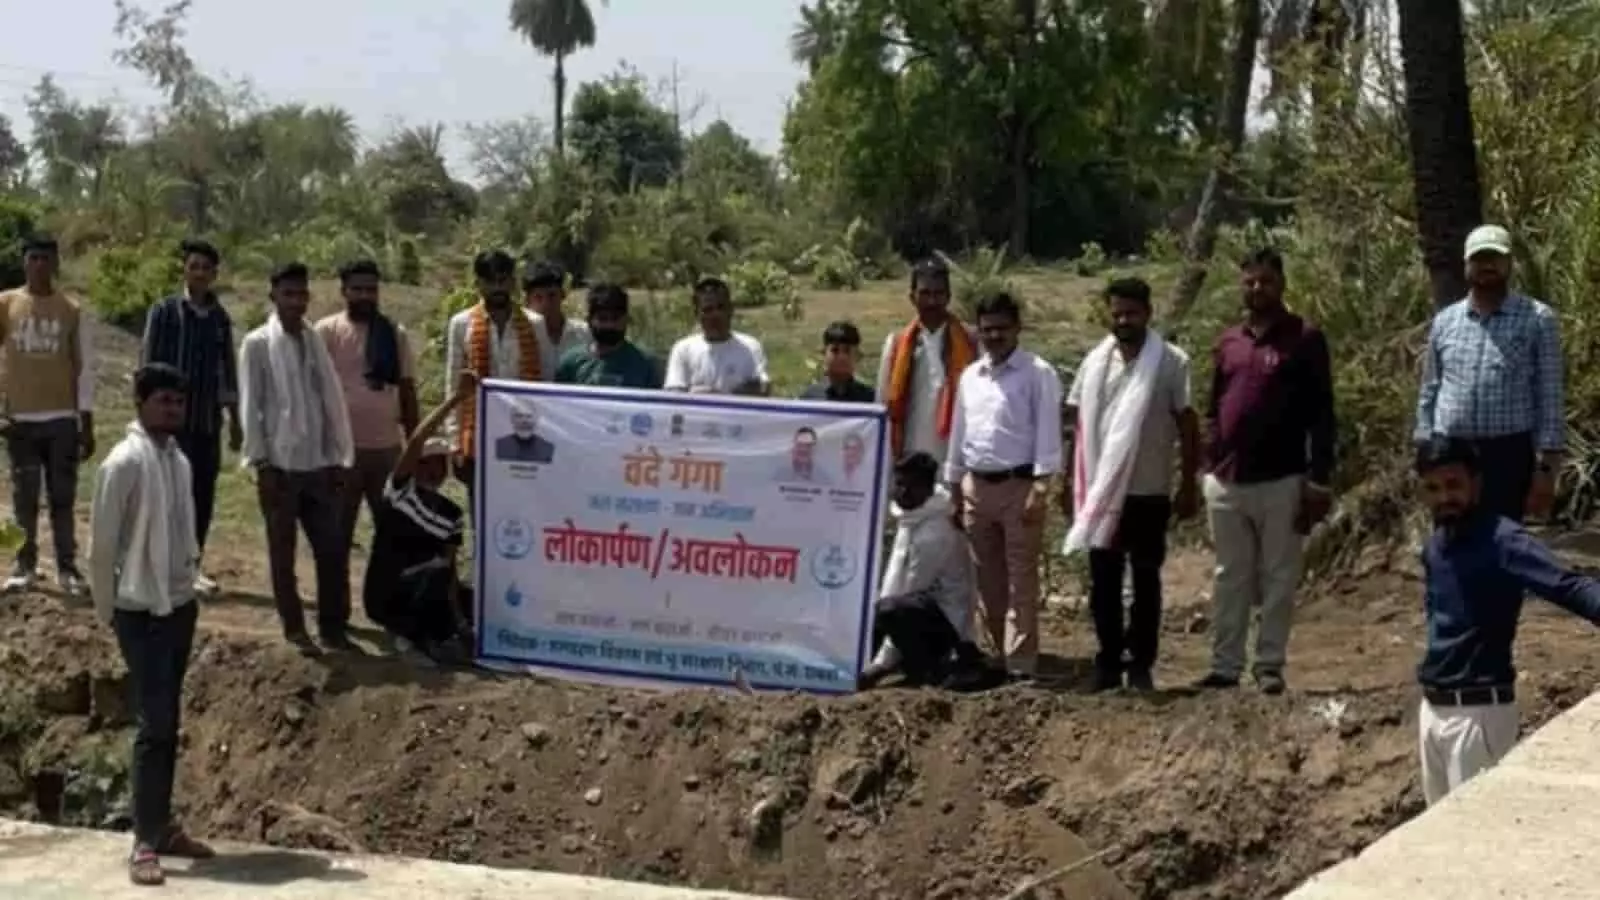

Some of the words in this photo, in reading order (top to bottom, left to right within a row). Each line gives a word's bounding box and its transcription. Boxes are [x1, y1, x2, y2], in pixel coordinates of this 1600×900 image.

[621, 446, 663, 488] वंदे
[669, 449, 727, 493] गंगा
[542, 517, 801, 584] लोकार्पण/अवलोकन
